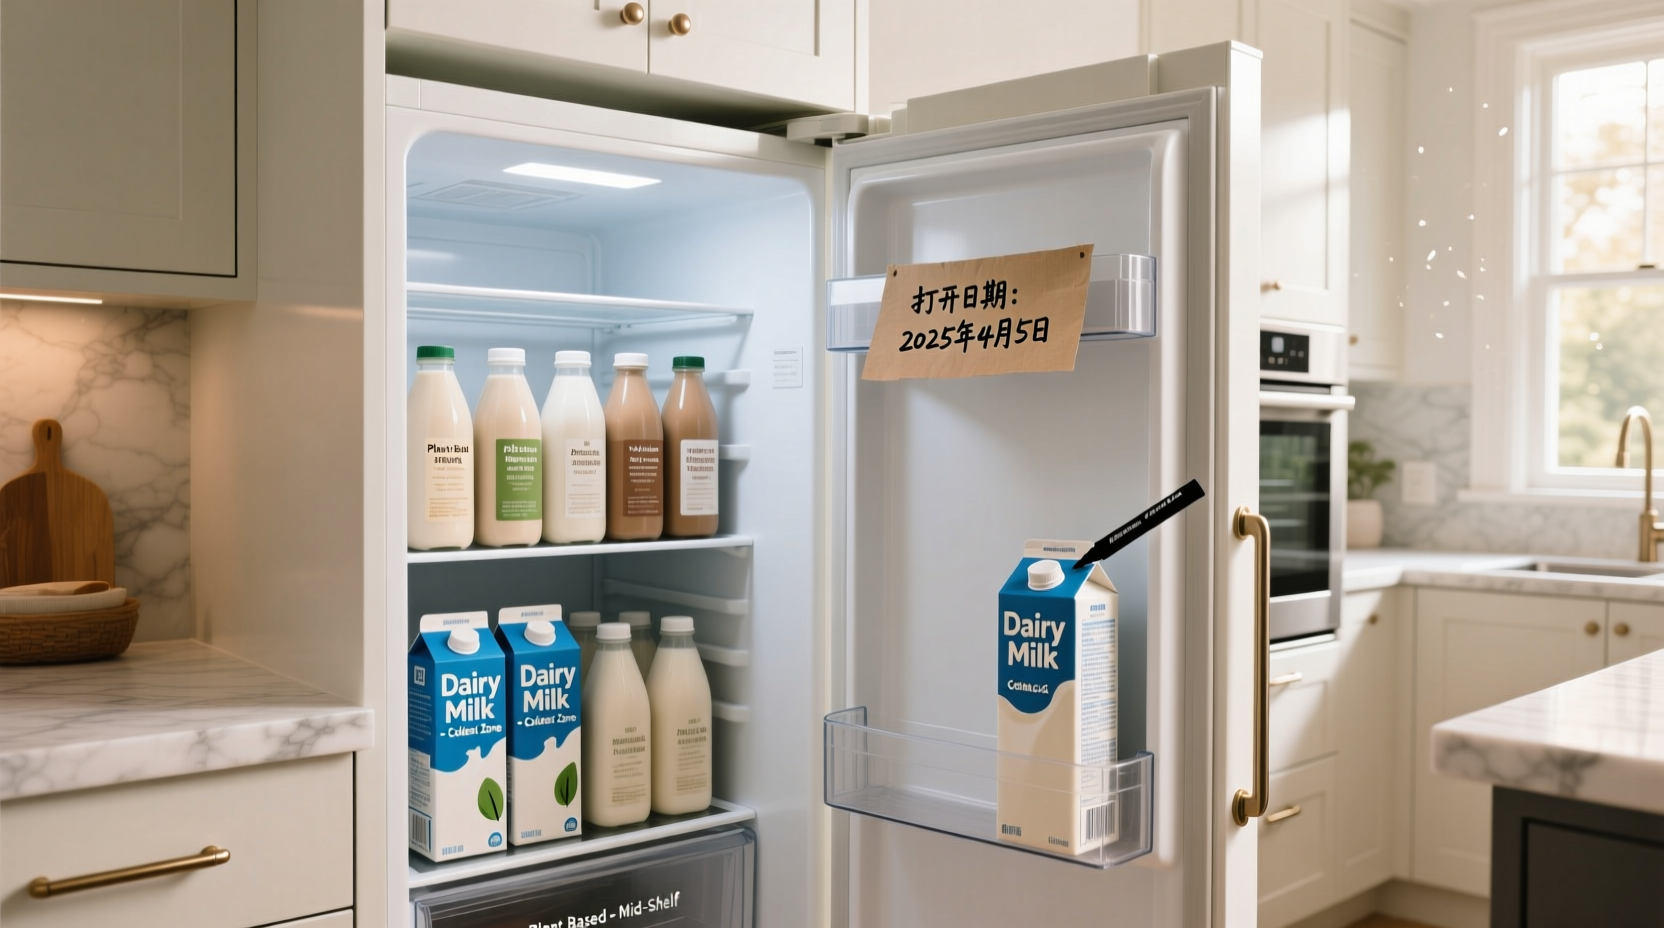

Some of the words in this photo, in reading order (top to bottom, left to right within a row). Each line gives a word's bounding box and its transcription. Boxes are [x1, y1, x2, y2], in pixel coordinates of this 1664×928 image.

[911, 279, 1018, 315] 打开日期：
[899, 316, 1049, 354] 2025年4月5日
[1003, 612, 1066, 647] Dairy
[1007, 640, 1059, 670] Milk
[441, 671, 501, 700] Dairy
[520, 662, 576, 689] Dairy
[445, 696, 495, 724] Milk
[523, 687, 570, 713] Milk
[567, 908, 607, 928] Based
[619, 891, 680, 919] Mid-Shelf
